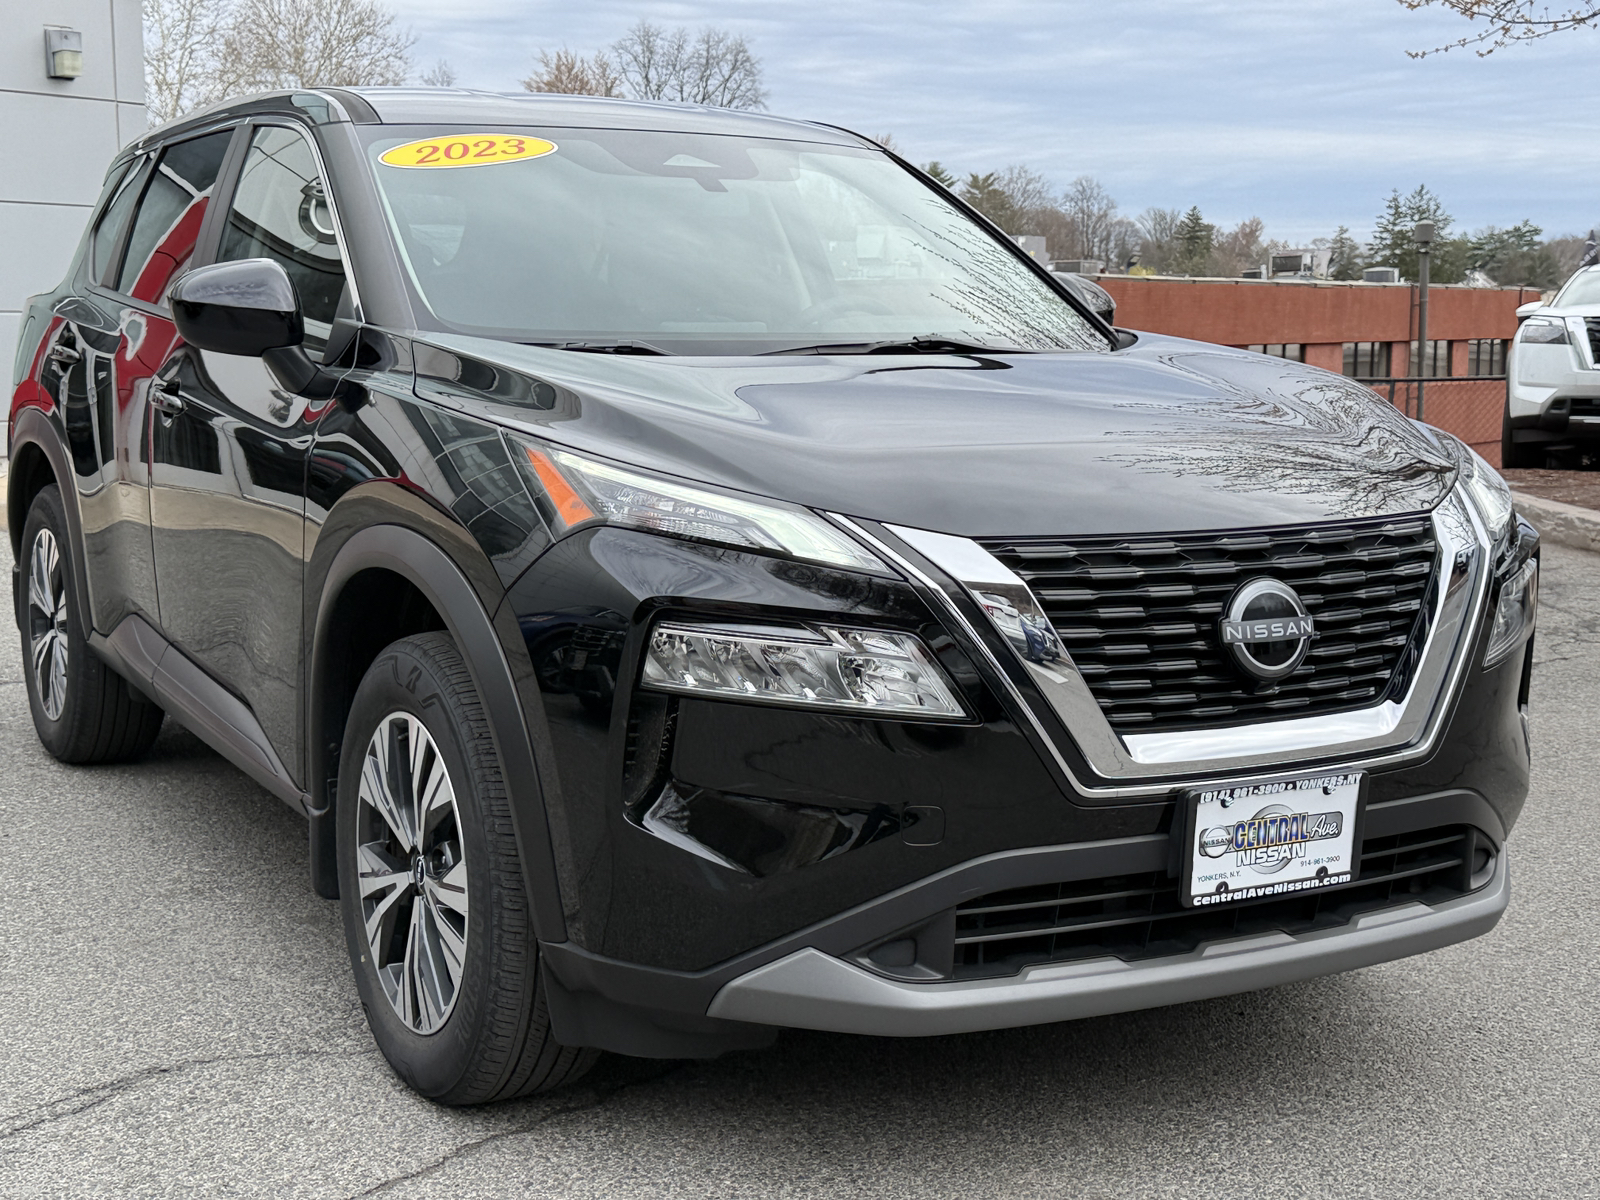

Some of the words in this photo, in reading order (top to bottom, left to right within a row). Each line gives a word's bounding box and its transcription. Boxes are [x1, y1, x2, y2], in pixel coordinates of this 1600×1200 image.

[415, 139, 526, 164] 2023
[1226, 619, 1312, 640] NISSAN
[1233, 782, 1287, 798] 961-3900
[1203, 837, 1231, 846] NISSAN
[1233, 812, 1310, 851] CENTRAL
[1310, 814, 1339, 838] Ave.
[1236, 842, 1306, 867] NISSAN
[1301, 855, 1340, 867] 914-961-3900
[1197, 872, 1229, 882] YONKERS,
[1230, 870, 1242, 878] N.Y.
[1193, 874, 1351, 906] CentralAveNissan.com
